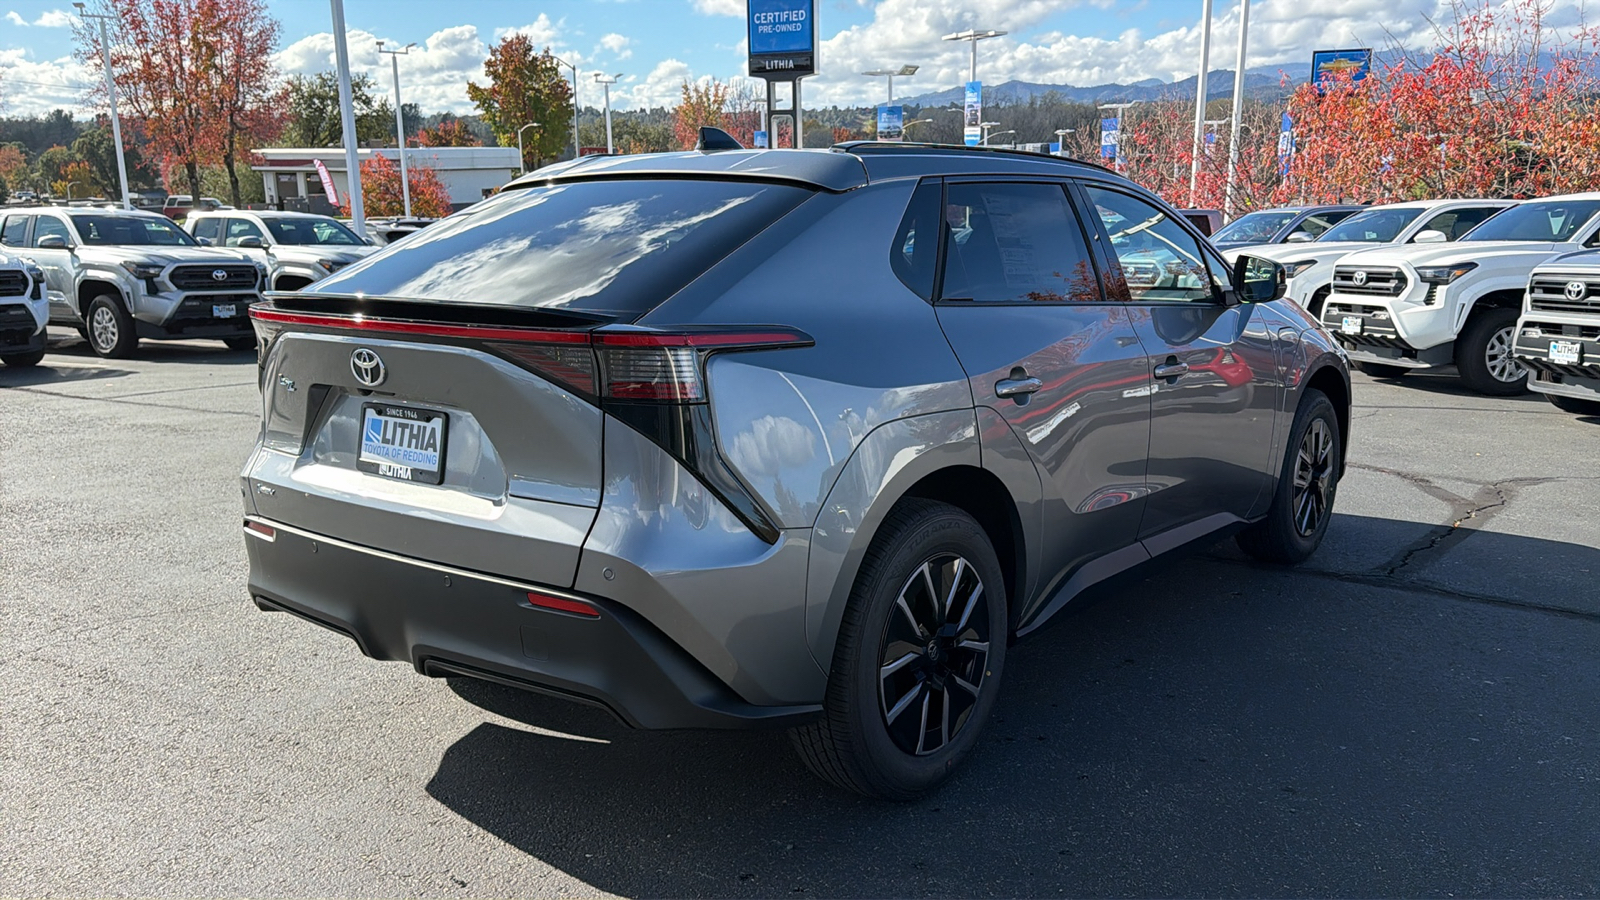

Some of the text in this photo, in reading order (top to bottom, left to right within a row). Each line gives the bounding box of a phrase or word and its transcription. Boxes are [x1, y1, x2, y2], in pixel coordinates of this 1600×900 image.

[754, 9, 806, 24] CERTIFIED
[758, 23, 802, 33] PRE-OWNED
[765, 59, 795, 70] LITHIA
[1556, 344, 1579, 354] LITHIA
[386, 407, 418, 419] SINCE 1946
[381, 419, 437, 453] LITHIA
[364, 443, 437, 466] TOYOTA OF REDDING
[385, 464, 412, 480] LITHIA
[907, 521, 961, 552] TURANZA
